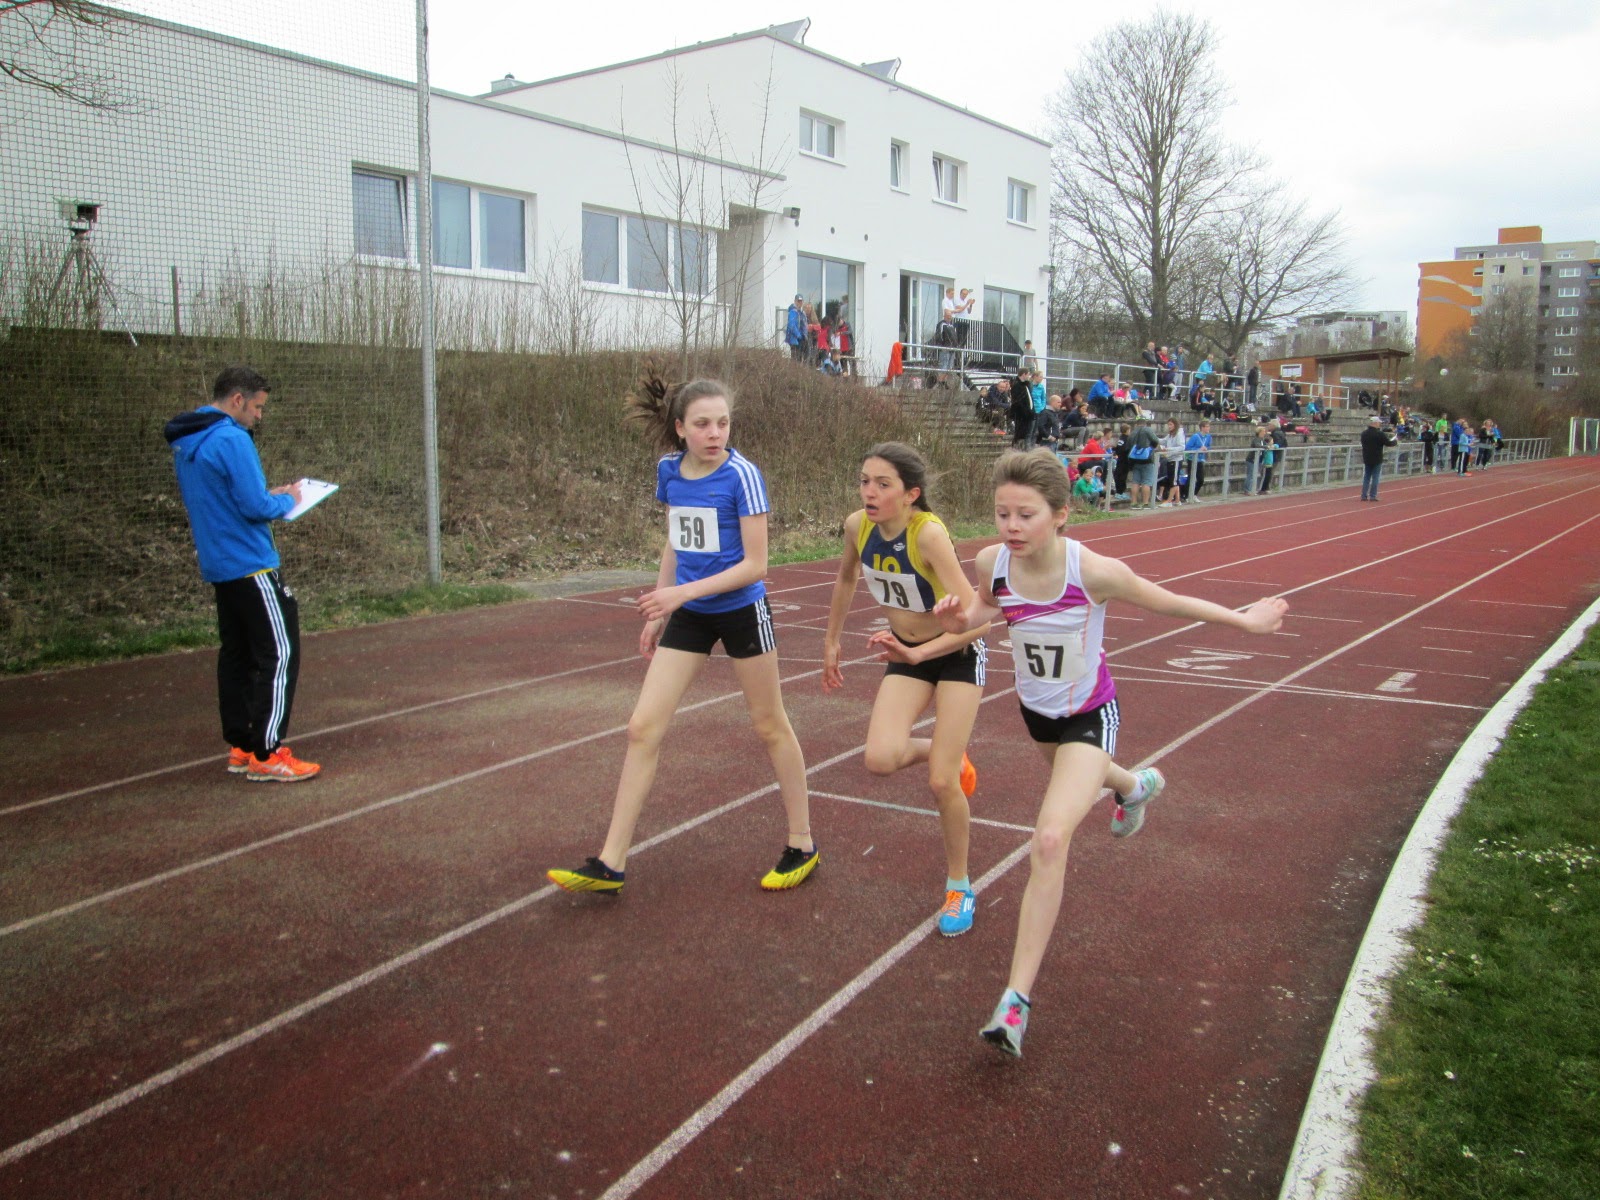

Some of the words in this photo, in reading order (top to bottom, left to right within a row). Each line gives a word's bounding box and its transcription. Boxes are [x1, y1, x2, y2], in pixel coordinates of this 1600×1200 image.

[679, 515, 706, 549] 59
[874, 577, 910, 608] 79
[1024, 642, 1064, 678] 57
